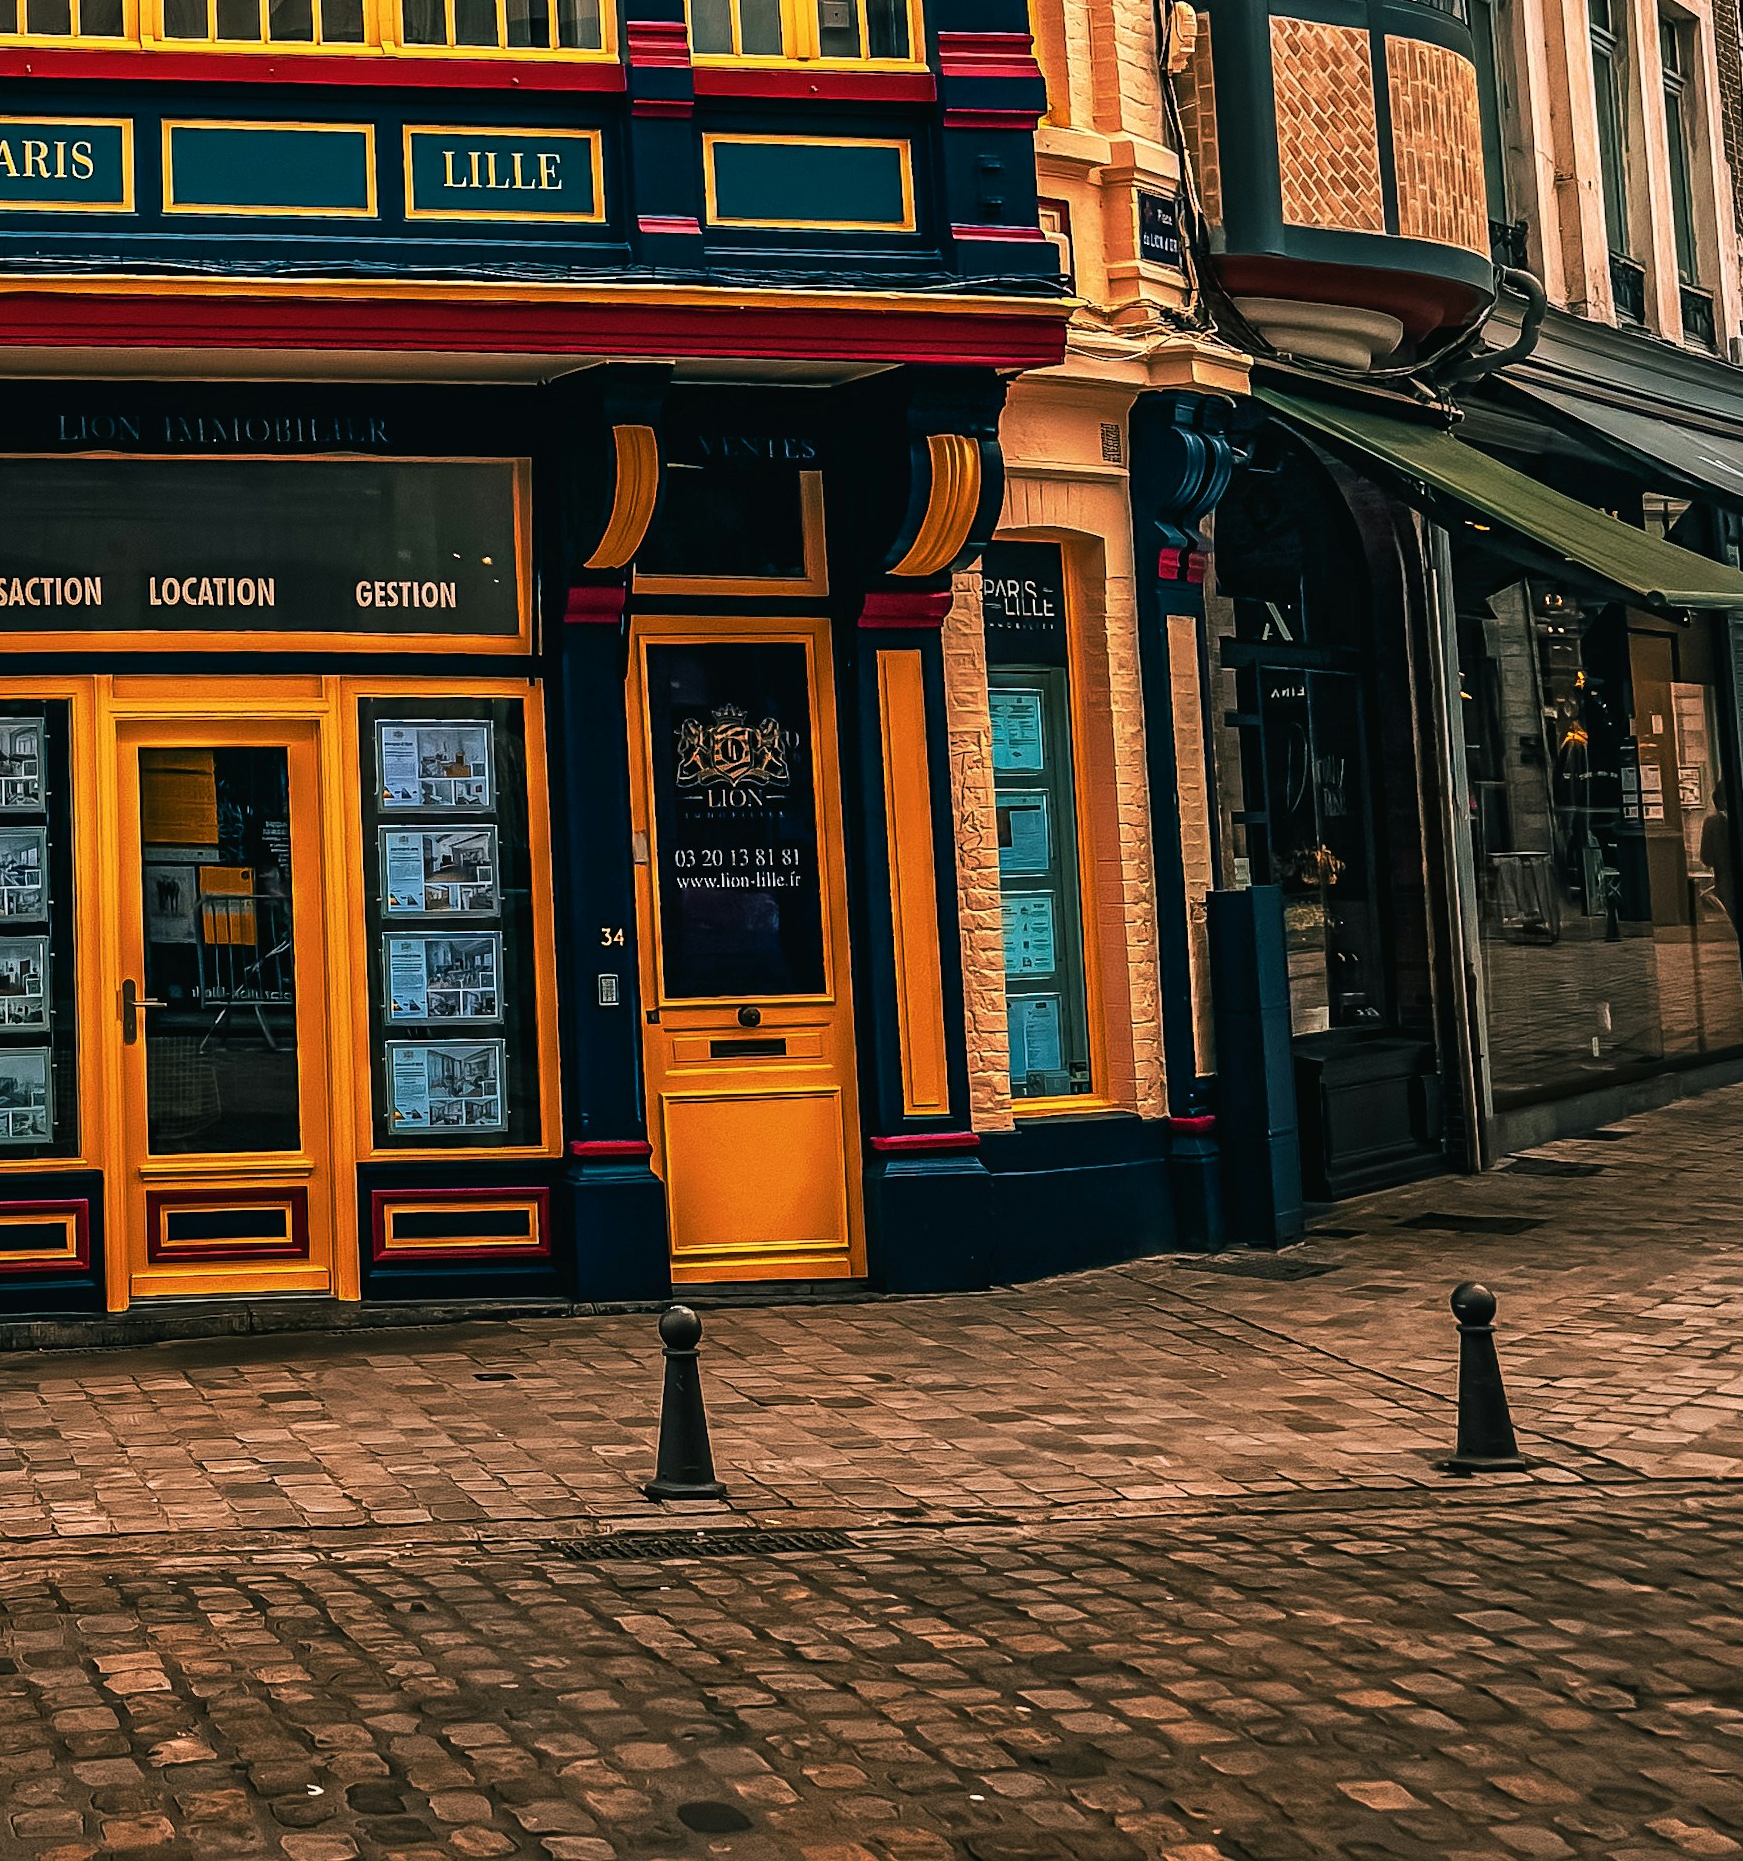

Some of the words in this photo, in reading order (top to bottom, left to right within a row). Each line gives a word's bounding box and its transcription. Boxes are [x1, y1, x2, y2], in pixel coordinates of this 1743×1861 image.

[442, 150, 563, 190] LILLE
[59, 415, 141, 441] LION
[148, 576, 276, 607] LOCATION
[355, 580, 457, 608] GESTION
[983, 579, 1037, 598] PARIS
[708, 788, 763, 808] LION
[674, 849, 696, 868] 03
[701, 849, 723, 867] 20
[731, 848, 749, 867] 13
[755, 848, 774, 866] 81
[781, 848, 799, 866] 81
[676, 871, 801, 889] www.lion-lille.fr
[600, 927, 625, 947] 34
